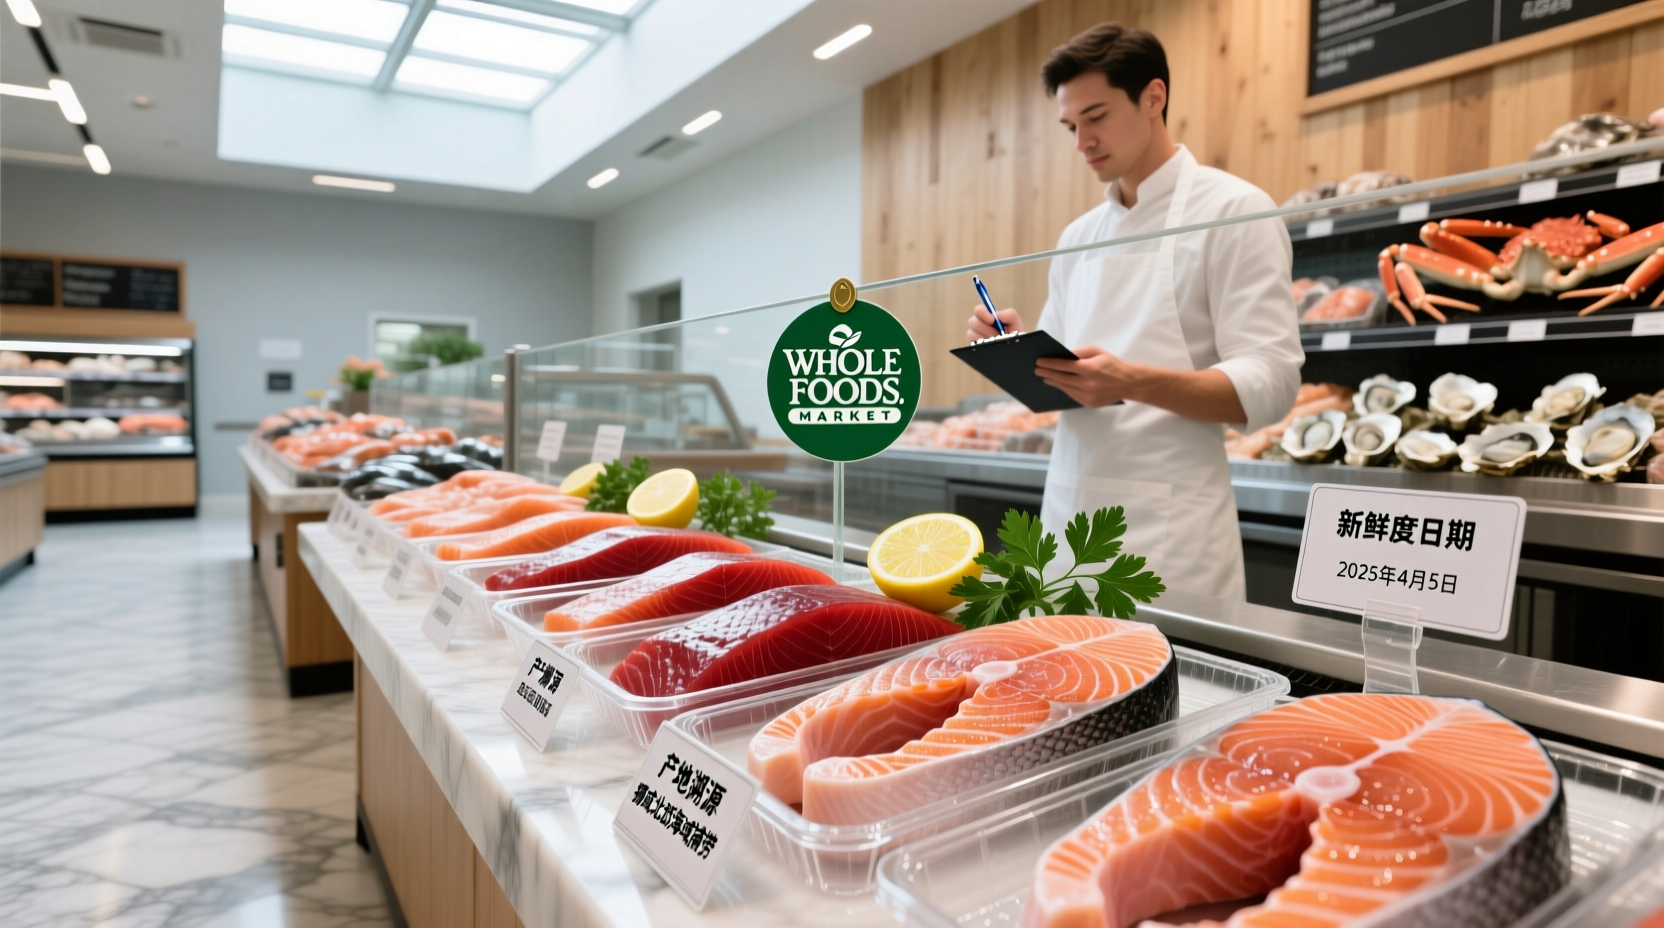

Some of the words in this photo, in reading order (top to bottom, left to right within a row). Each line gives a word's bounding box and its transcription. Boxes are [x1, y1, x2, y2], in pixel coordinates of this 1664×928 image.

[782, 348, 902, 376] WHOLE
[799, 410, 891, 422] MARKET
[1336, 508, 1477, 552] 新鲜度日期
[1336, 560, 1458, 595] 2025年4月5日
[657, 752, 728, 817] 产地溯源
